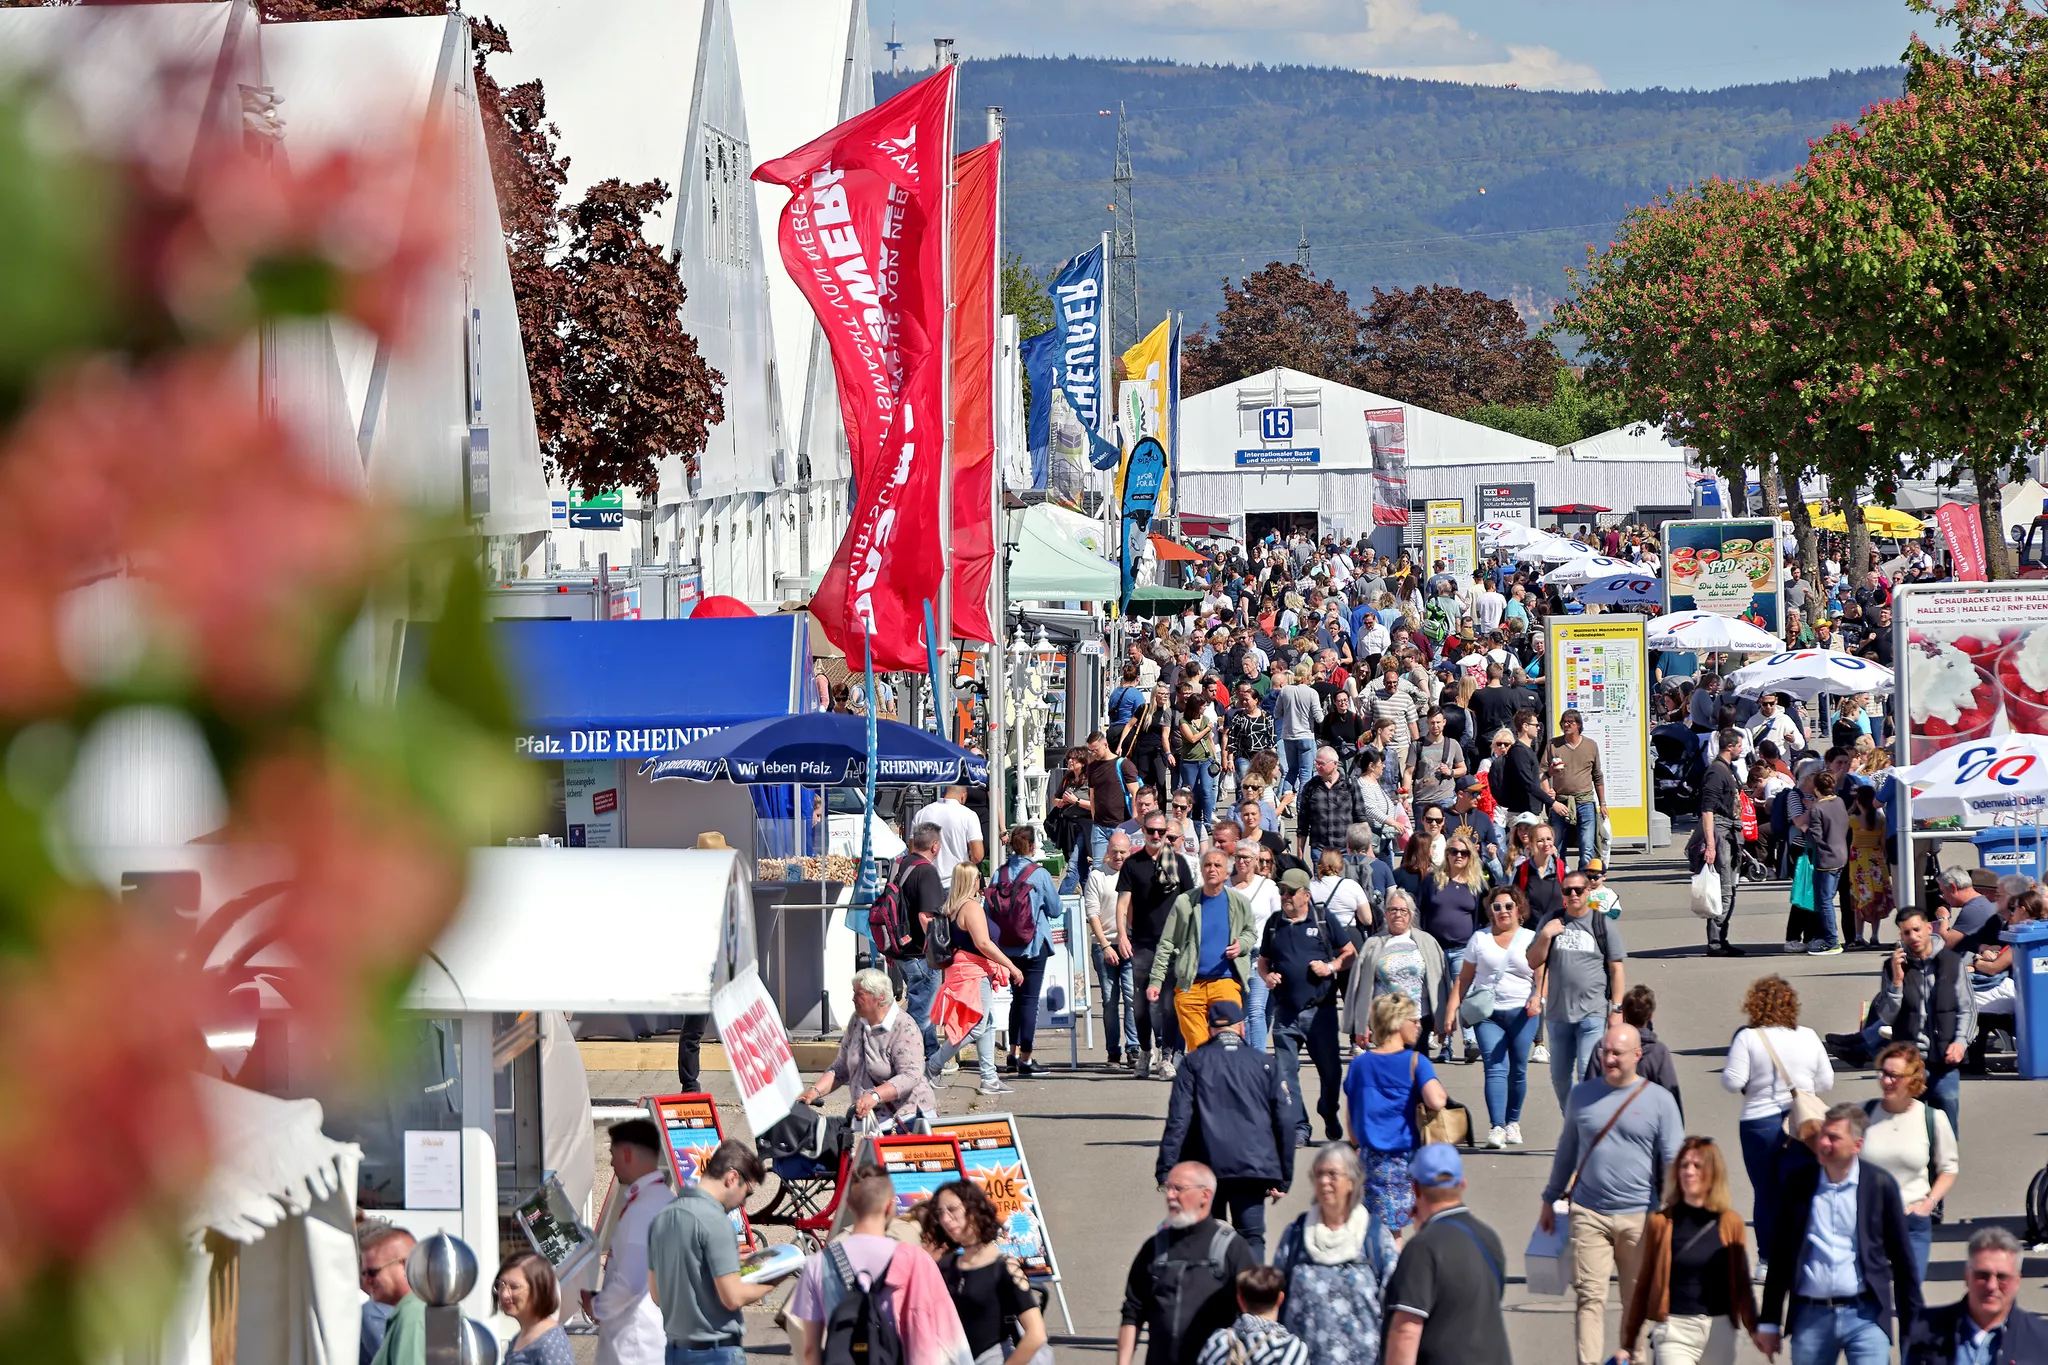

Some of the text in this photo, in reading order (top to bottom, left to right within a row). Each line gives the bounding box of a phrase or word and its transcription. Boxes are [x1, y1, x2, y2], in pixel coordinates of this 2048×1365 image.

[1266, 410, 1289, 436] 15
[600, 512, 622, 522] WC
[1493, 510, 1522, 518] HALLE
[1698, 582, 1712, 590] Du
[1934, 596, 2012, 605] SCHAUBACKSTUBE
[570, 730, 611, 752] DIE
[738, 761, 832, 776] Wir leben Pfalz.
[880, 760, 955, 775] RHEINPFALZ
[1972, 795, 2046, 810] Odenwald Quelle
[985, 1178, 1016, 1199] 40€
[997, 1200, 1022, 1212] TRA!
